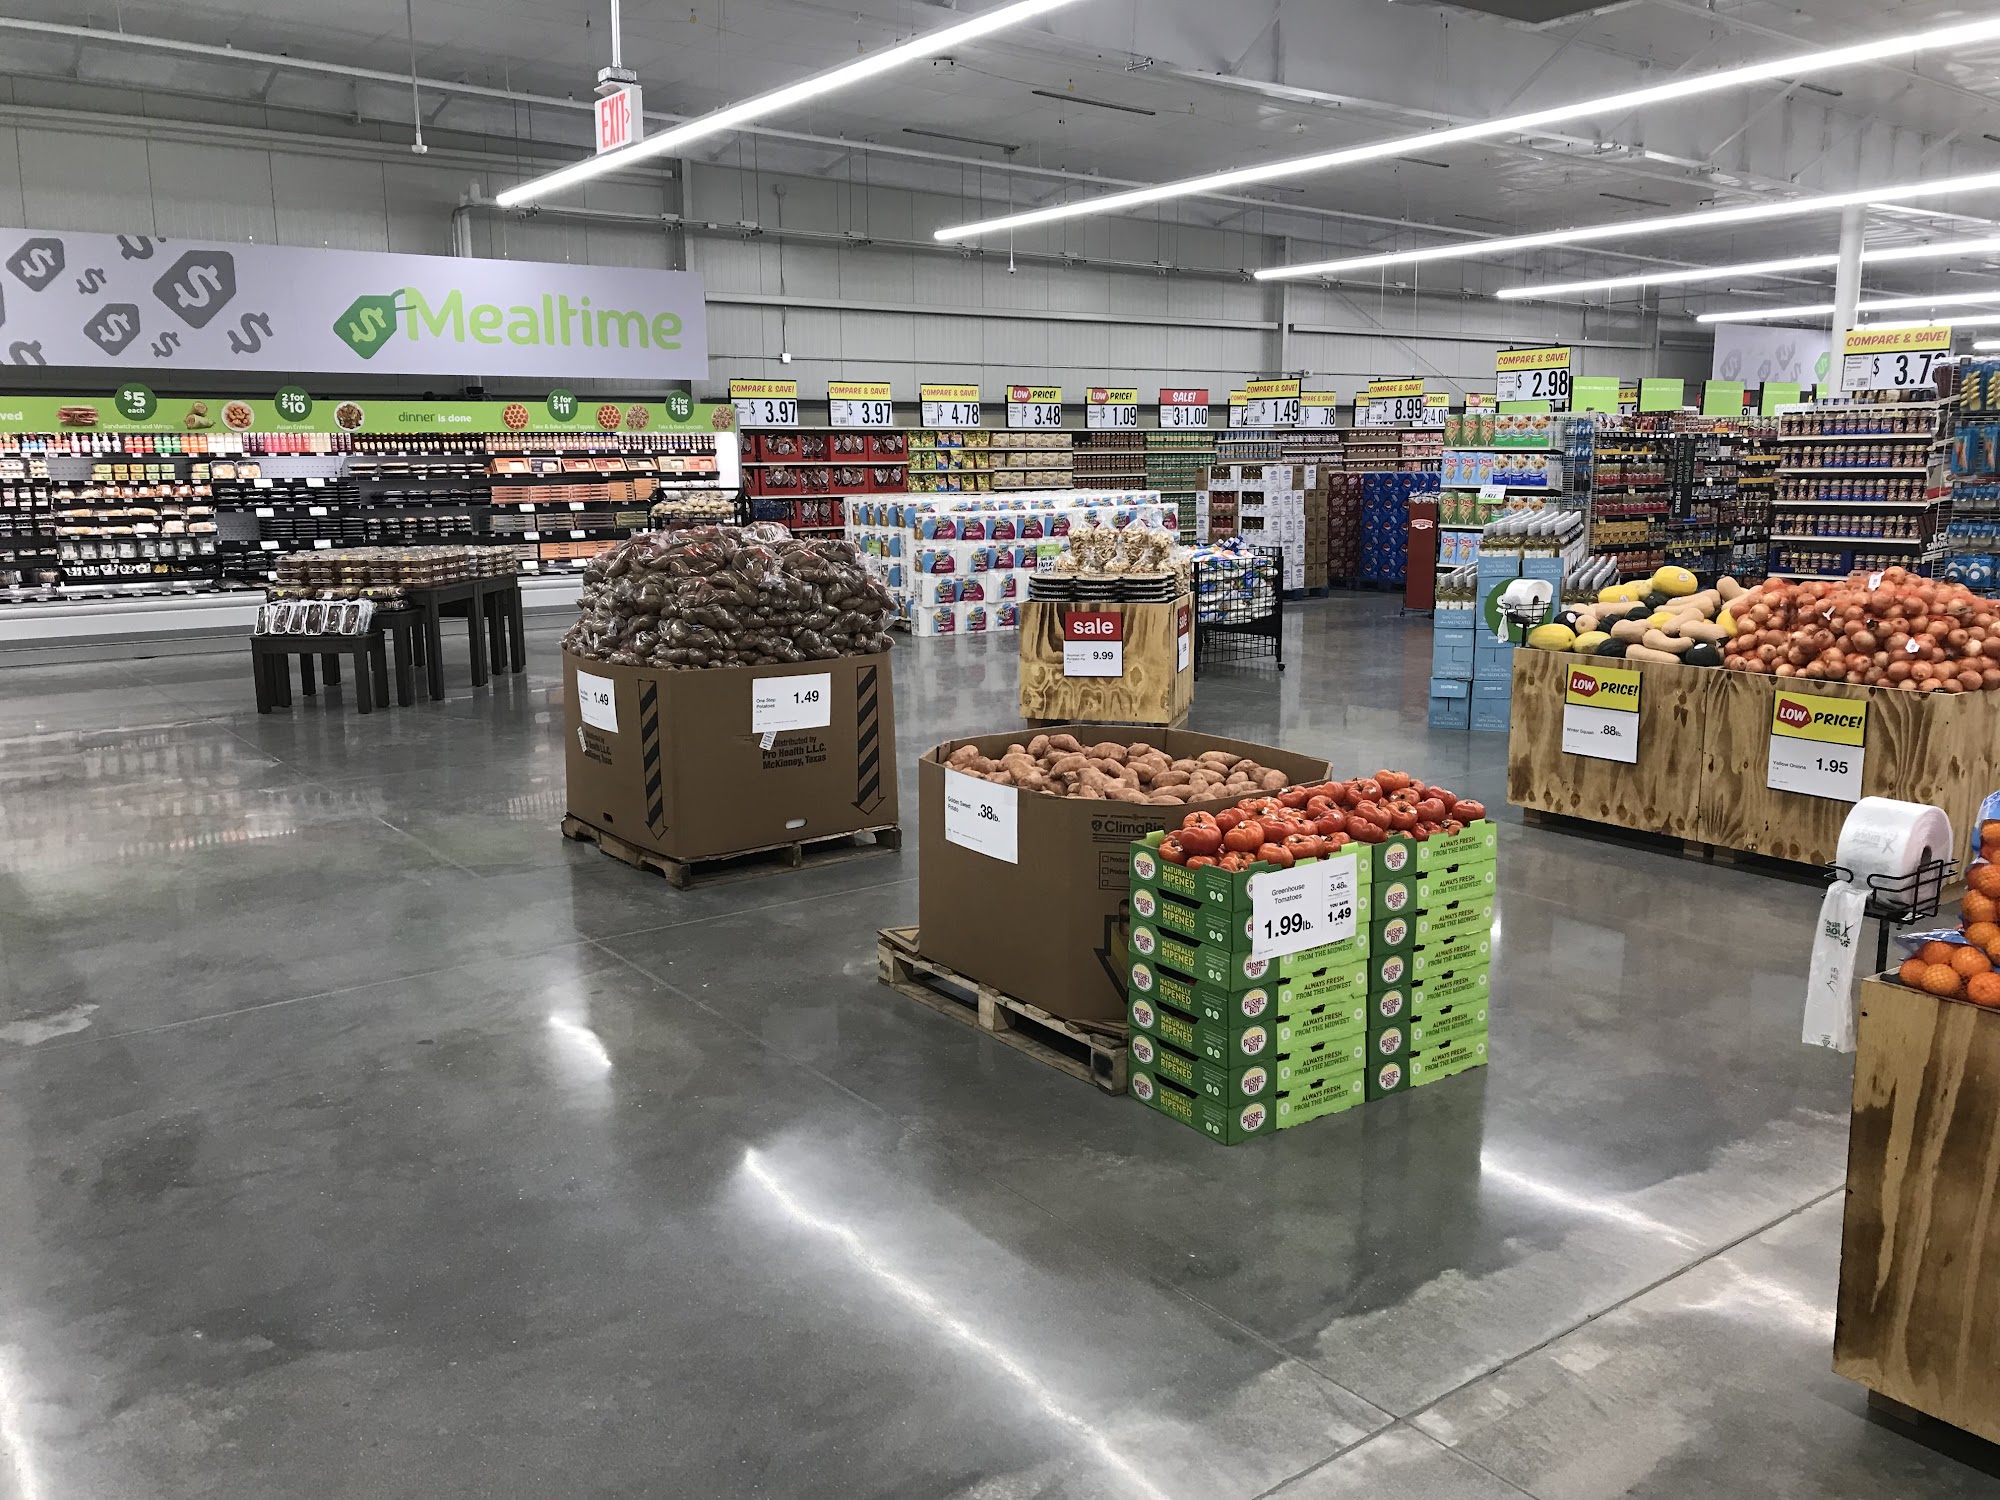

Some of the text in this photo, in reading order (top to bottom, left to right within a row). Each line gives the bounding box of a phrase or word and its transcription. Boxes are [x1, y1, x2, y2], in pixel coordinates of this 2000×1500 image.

[601, 92, 625, 148] EXIT
[404, 286, 682, 349] Mealtime
[1846, 330, 1947, 346] COMPARE & SAVE!
[1498, 352, 1567, 365] COMPARE & SAVE!
[1873, 356, 1879, 377] $
[731, 384, 794, 393] COMPARE & SAVE!
[830, 386, 862, 395] COMPARE
[871, 387, 888, 395] SAVE!
[1247, 385, 1273, 393] COMPARE
[1369, 385, 1397, 393] COMPARE
[1517, 370, 1567, 397] $ 2.98
[123, 391, 146, 407] $5
[282, 393, 304, 402] 2 for
[922, 388, 951, 396] COMPARE
[959, 389, 976, 397] SAVE!
[1013, 390, 1056, 399] LOW PRICE!
[1092, 391, 1132, 400] LOW PRICE!
[1172, 391, 1196, 402] SALE!
[281, 399, 305, 413] $10
[553, 403, 569, 414] $11
[671, 405, 688, 415] $15
[750, 401, 796, 423] $ 3.97
[848, 403, 852, 417] $
[861, 402, 890, 424] 3.97
[1261, 401, 1265, 414] $
[1273, 400, 1298, 422] 1.49
[1383, 400, 1387, 412] $
[1395, 398, 1421, 419] 8.99
[398, 412, 472, 423] dinner is done
[938, 404, 943, 417] $
[951, 404, 978, 424] 4.78
[1023, 405, 1027, 417] $
[1034, 405, 1060, 425] 3.48
[1102, 407, 1105, 418] $
[1112, 406, 1136, 425] 1.09
[1174, 407, 1180, 425] 3
[1185, 407, 1207, 425] 1.00
[1306, 408, 1334, 425] $ .78
[1423, 408, 1427, 424] 2
[1073, 618, 1113, 634] sale
[1093, 651, 1113, 660] 9.99
[1572, 678, 1638, 696] LOW PRICE!
[594, 691, 608, 705] 1.49
[793, 690, 818, 703] 1.49
[1779, 707, 1862, 728] LOW PRICE!
[773, 736, 807, 747] Distributed
[762, 743, 826, 759] Pro Health L.L.C.
[763, 754, 826, 769] McKinney, Texas
[1816, 757, 1848, 774] 1.95
[948, 795, 959, 804] Golden
[948, 803, 958, 812] Potato
[1387, 852, 1405, 860] BUSHEL
[1136, 859, 1153, 872] BUSHEL
[1391, 859, 1400, 868] BOY
[1140, 868, 1149, 876] BOY
[1162, 864, 1195, 878] NATURALLY
[1162, 872, 1195, 889] RIPENED
[1171, 883, 1181, 892] THE
[1182, 886, 1195, 895] VINE
[1271, 883, 1305, 896] Greenhouse
[1274, 894, 1302, 904] Tomatoes
[1327, 907, 1351, 922] 1.49
[1301, 1085, 1340, 1102] ALWAYS FRESH
[1294, 1090, 1348, 1112] FROM THE MIDWEST
[1243, 1111, 1263, 1123] BUSHEL
[1247, 1120, 1258, 1129] BOY
